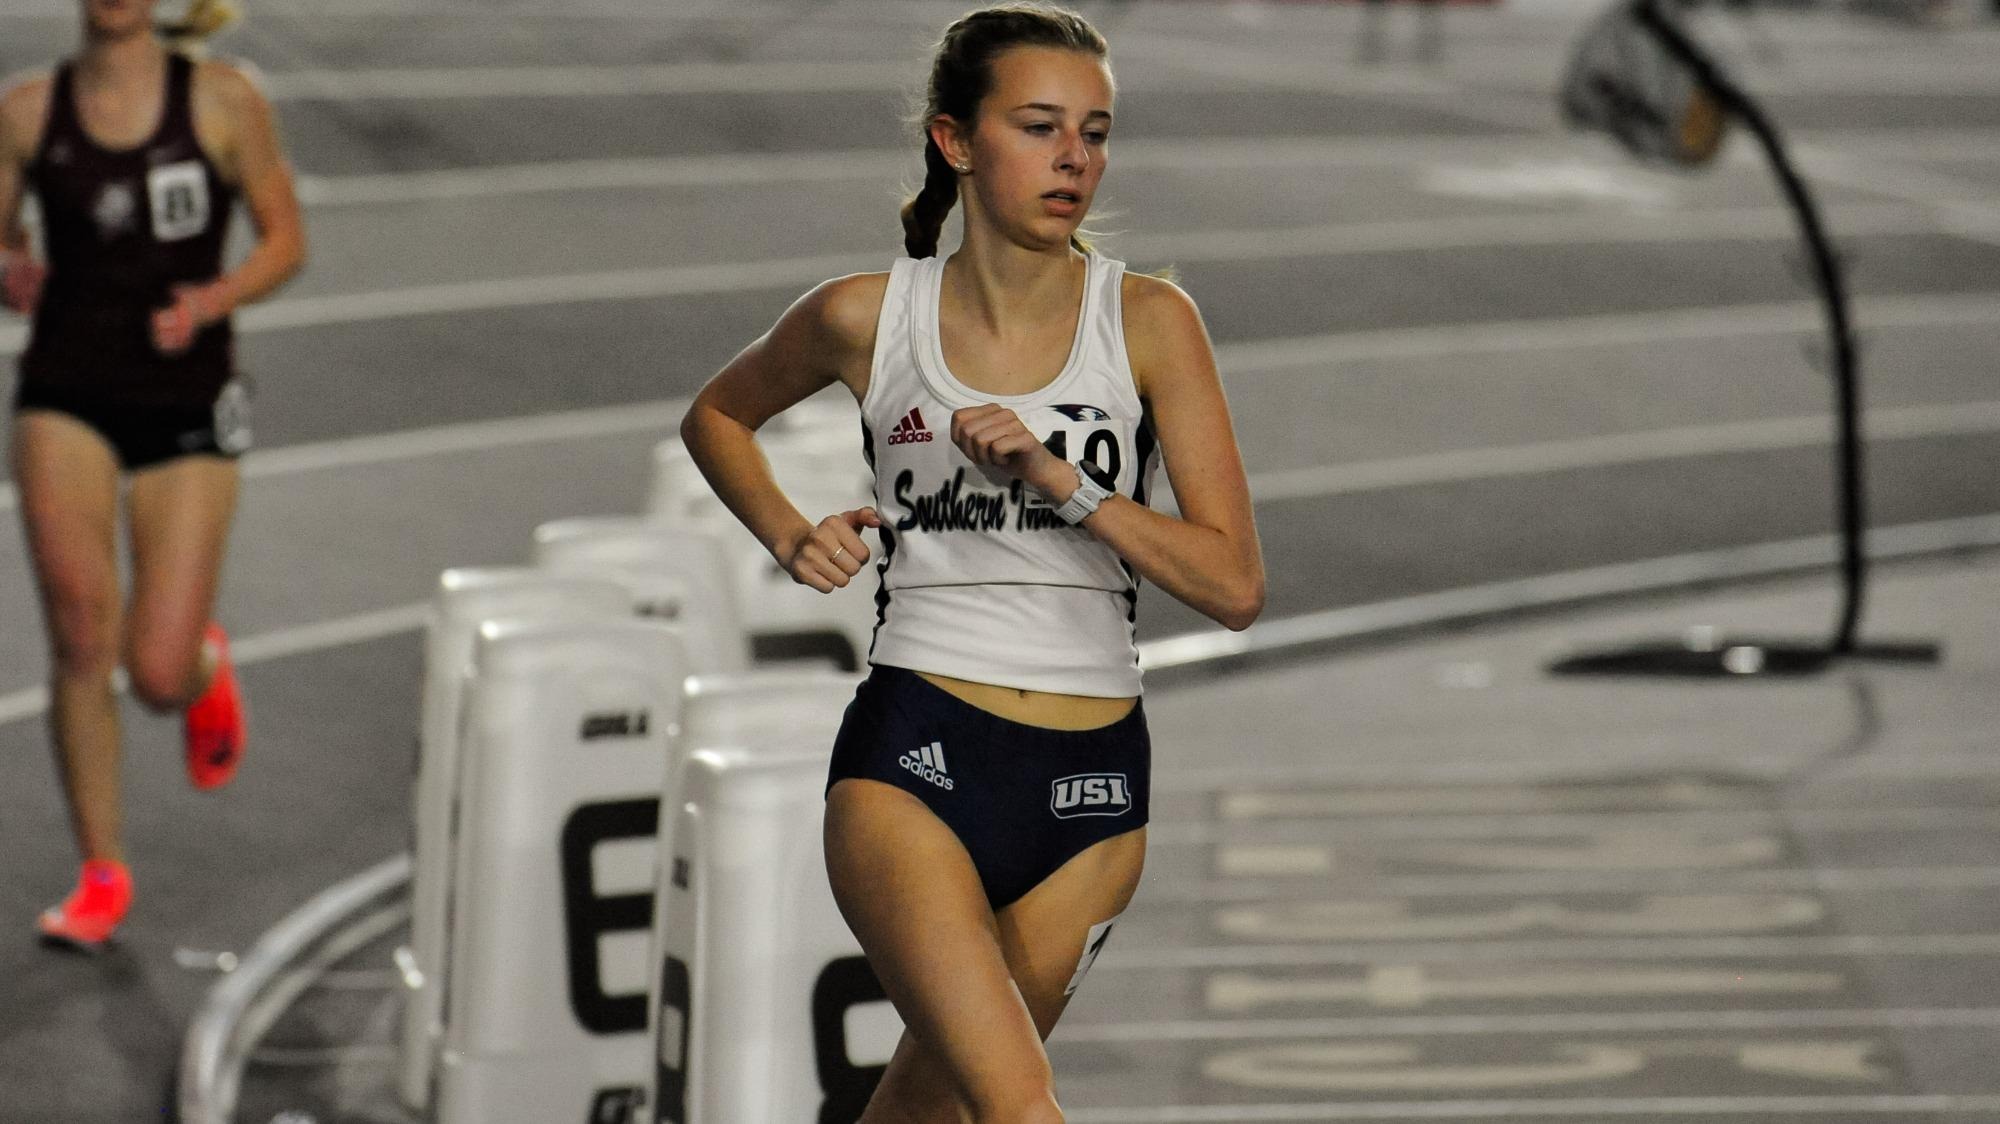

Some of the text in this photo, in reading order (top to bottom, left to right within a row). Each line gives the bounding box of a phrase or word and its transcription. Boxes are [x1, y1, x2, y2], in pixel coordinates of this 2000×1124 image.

[887, 430, 933, 446] adidas
[894, 466, 1006, 533] Southern
[899, 754, 954, 791] adidas
[1054, 776, 1128, 810] USI
